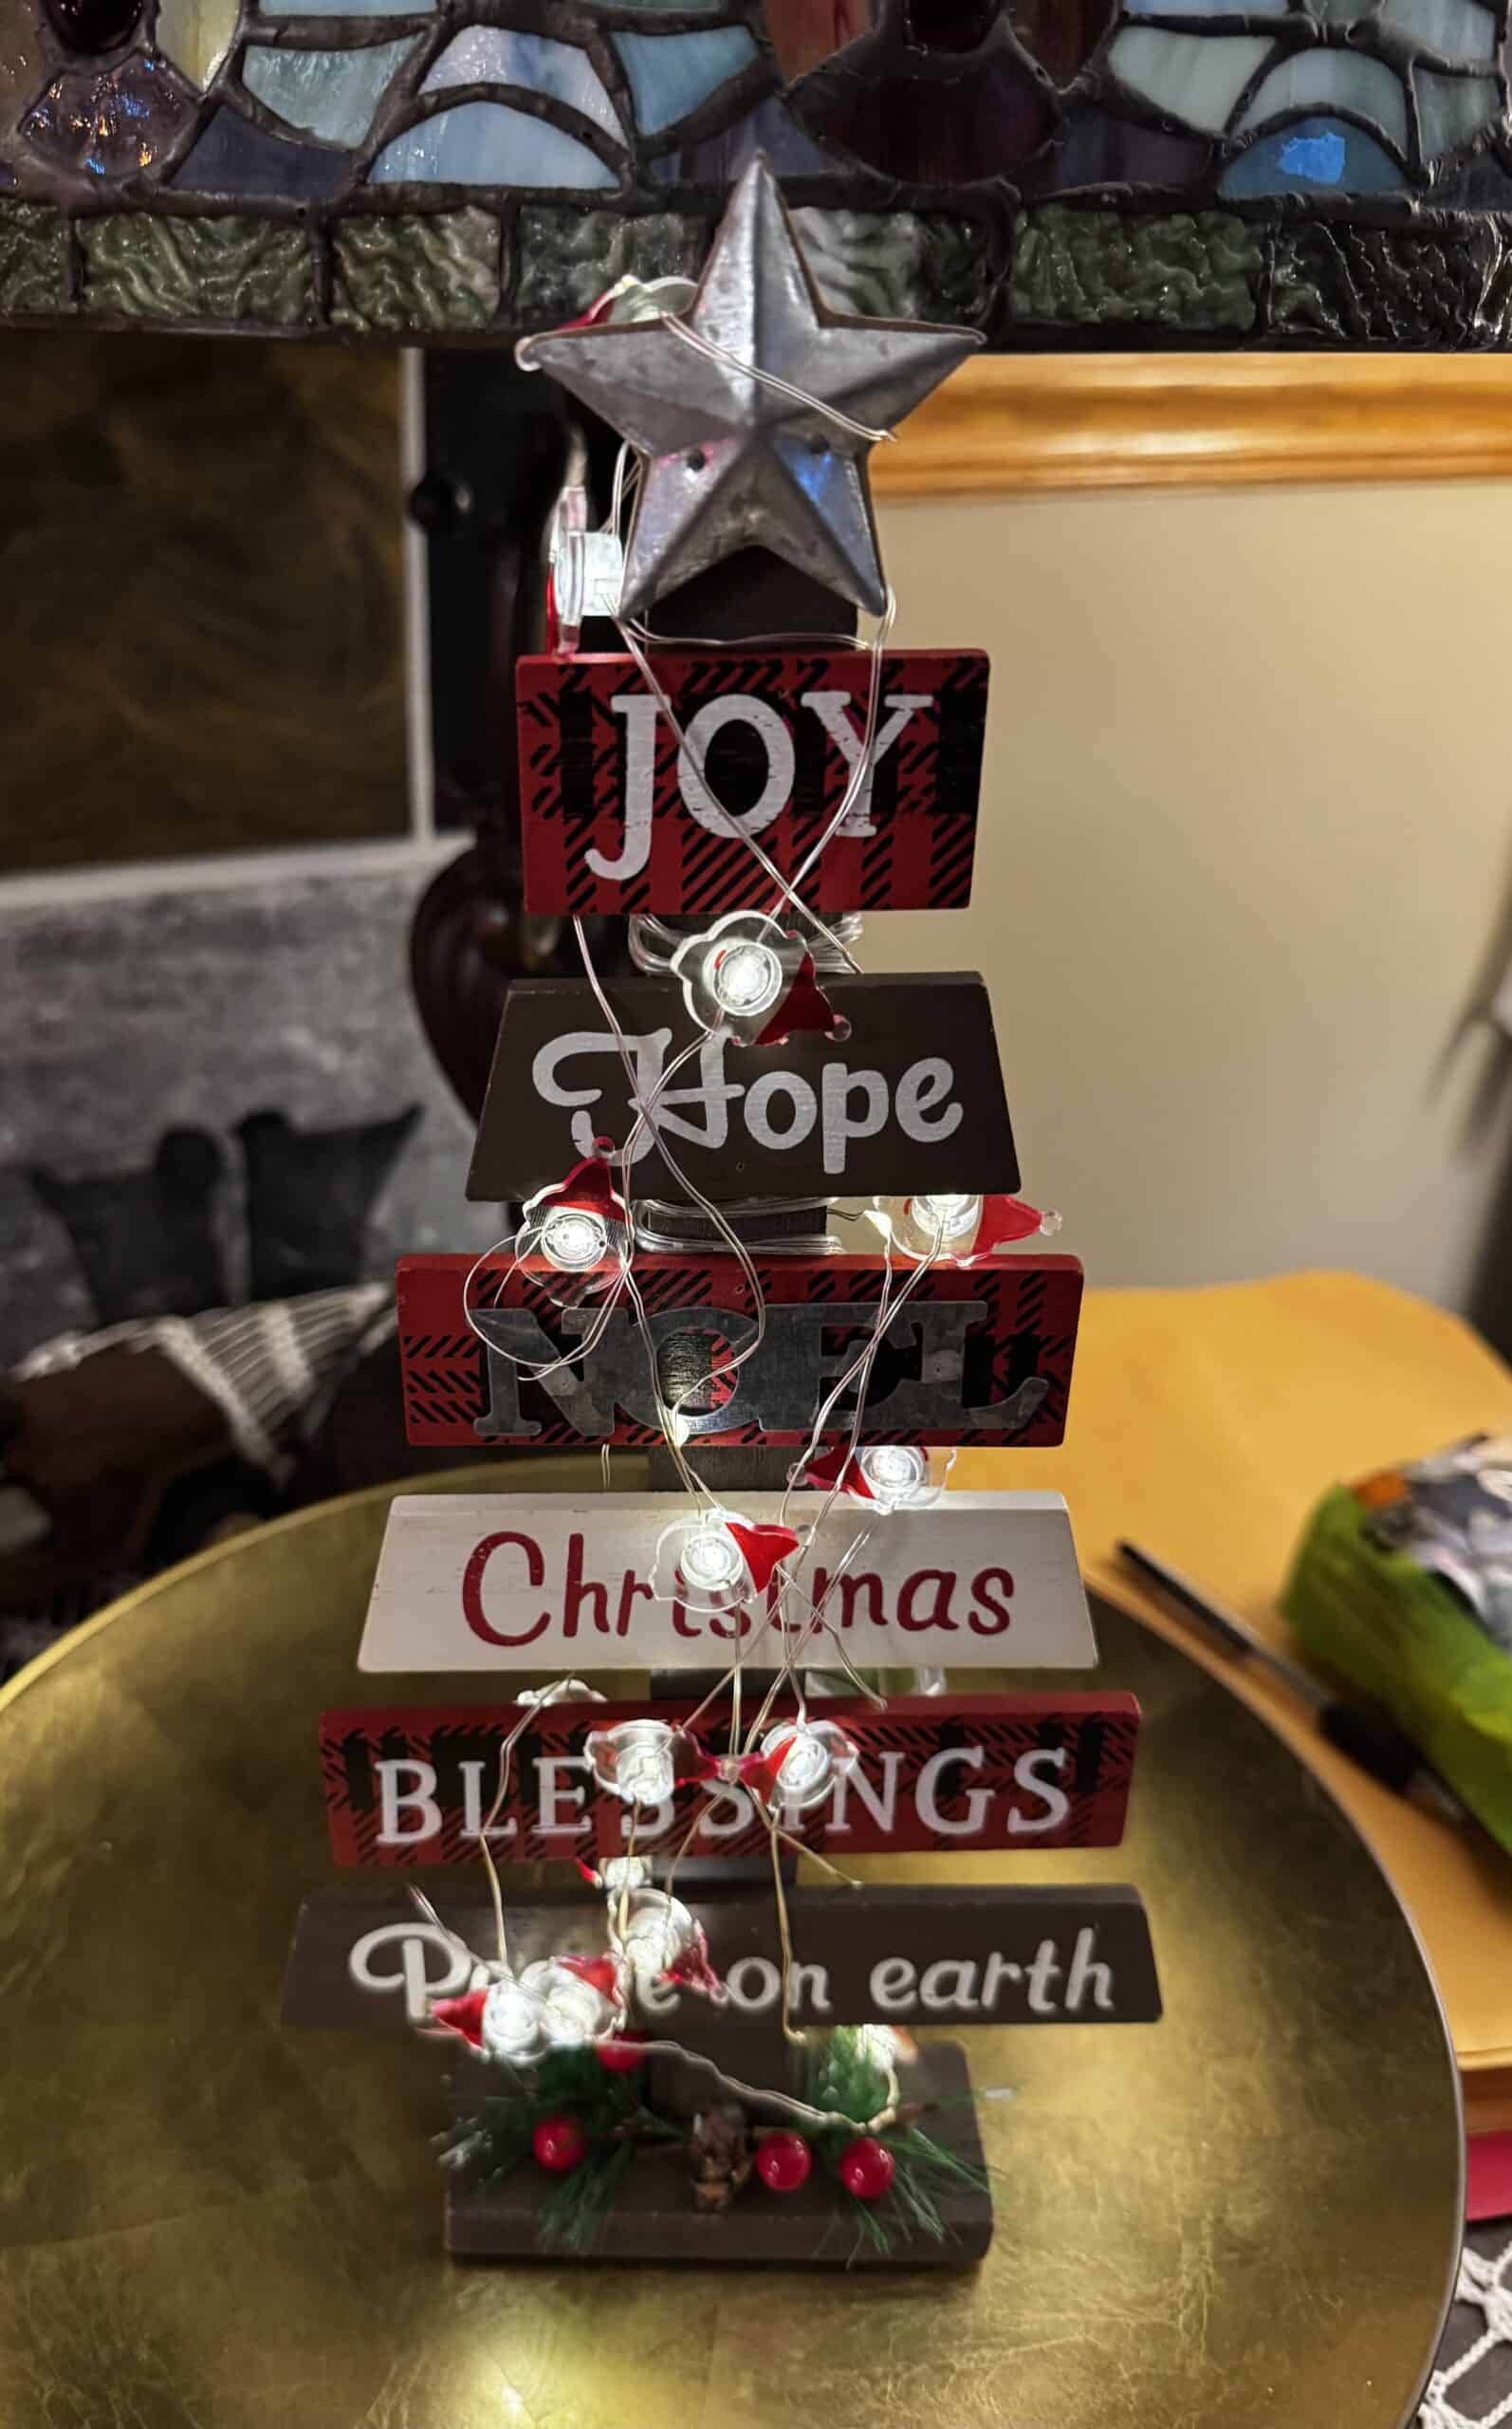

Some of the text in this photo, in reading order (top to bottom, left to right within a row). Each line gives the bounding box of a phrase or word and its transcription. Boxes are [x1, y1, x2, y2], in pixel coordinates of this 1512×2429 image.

[584, 692, 933, 880] JOY
[532, 1028, 963, 1174] Hope
[472, 1300, 1049, 1436] NOEL
[727, 1956, 832, 2011] on
[870, 1927, 1115, 2012] earth
